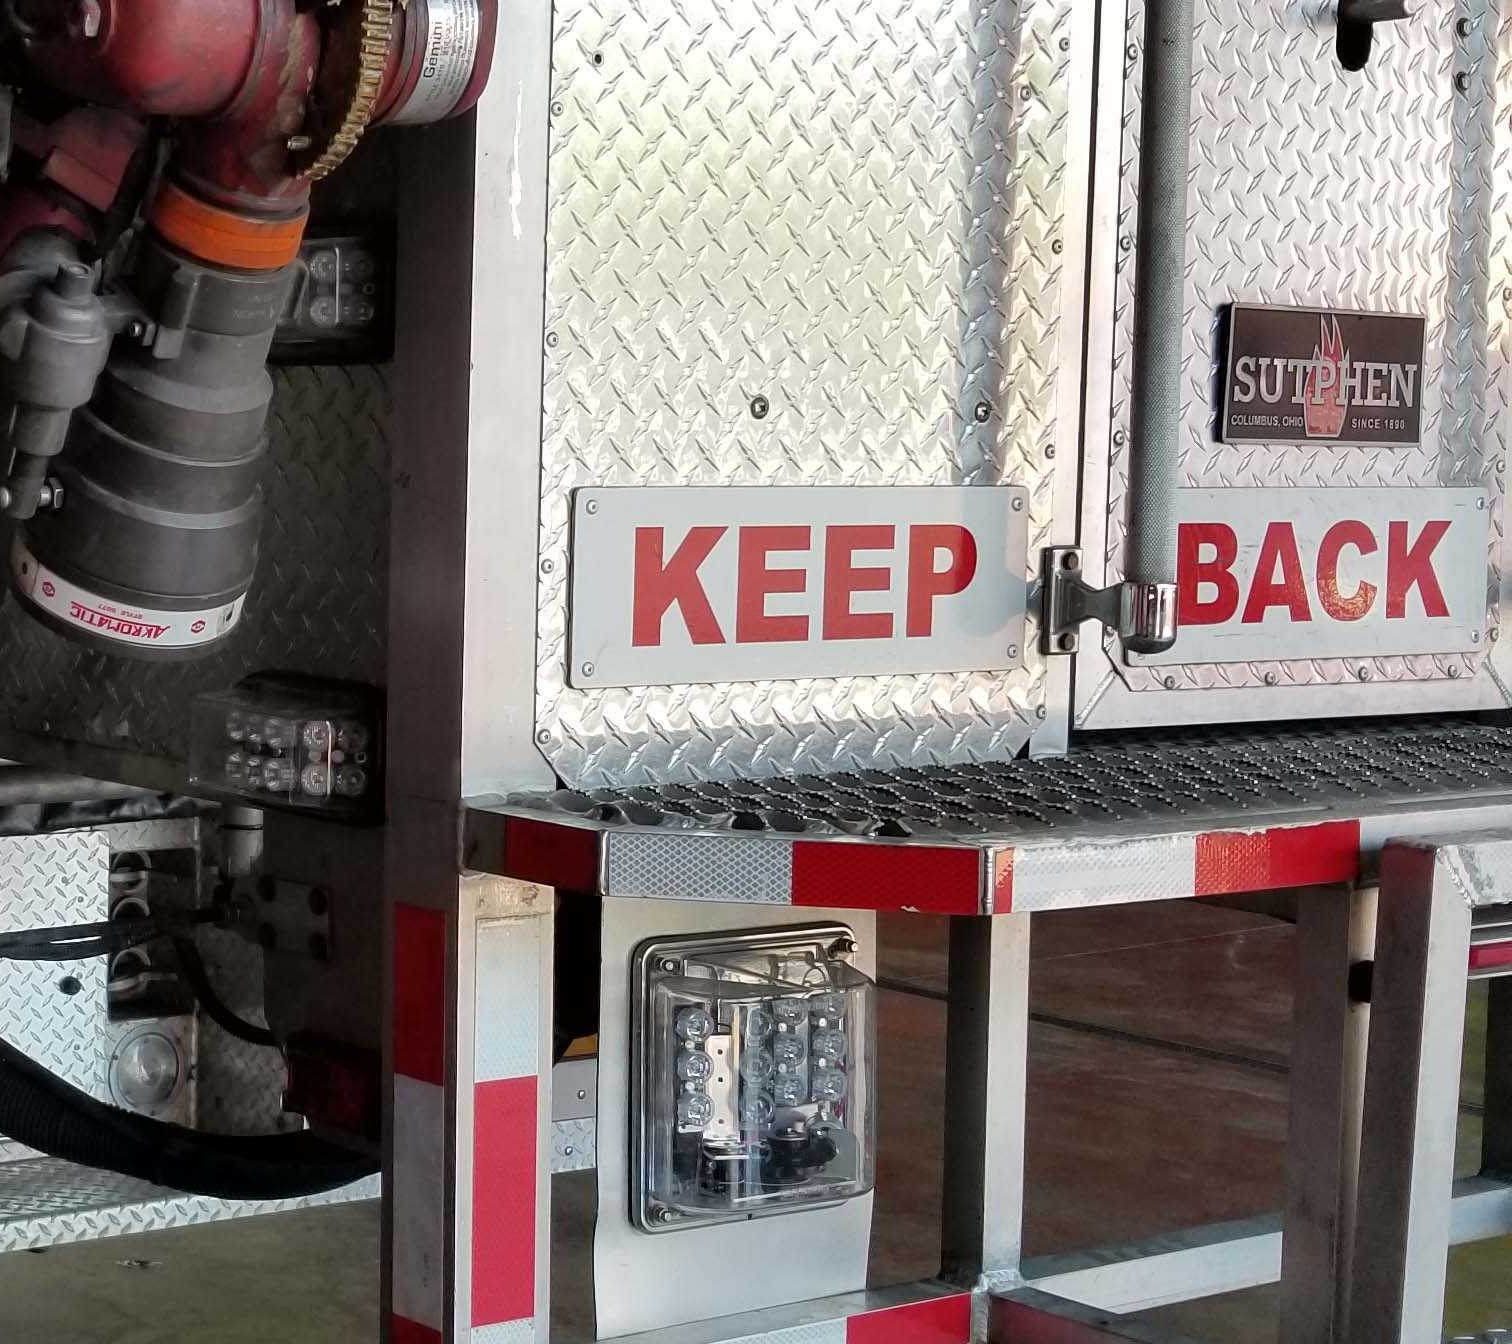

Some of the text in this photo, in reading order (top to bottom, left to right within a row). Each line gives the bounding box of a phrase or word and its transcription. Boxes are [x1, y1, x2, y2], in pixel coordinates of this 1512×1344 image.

[424, 22, 442, 78] Gemini
[1233, 356, 1417, 407] SUTPHEN
[1231, 414, 1304, 427] COLUMBUS, OHIO
[1351, 418, 1405, 430] SINCE 1890
[631, 520, 1453, 648] KEEP BACK
[70, 605, 171, 640] AKROMATIC
